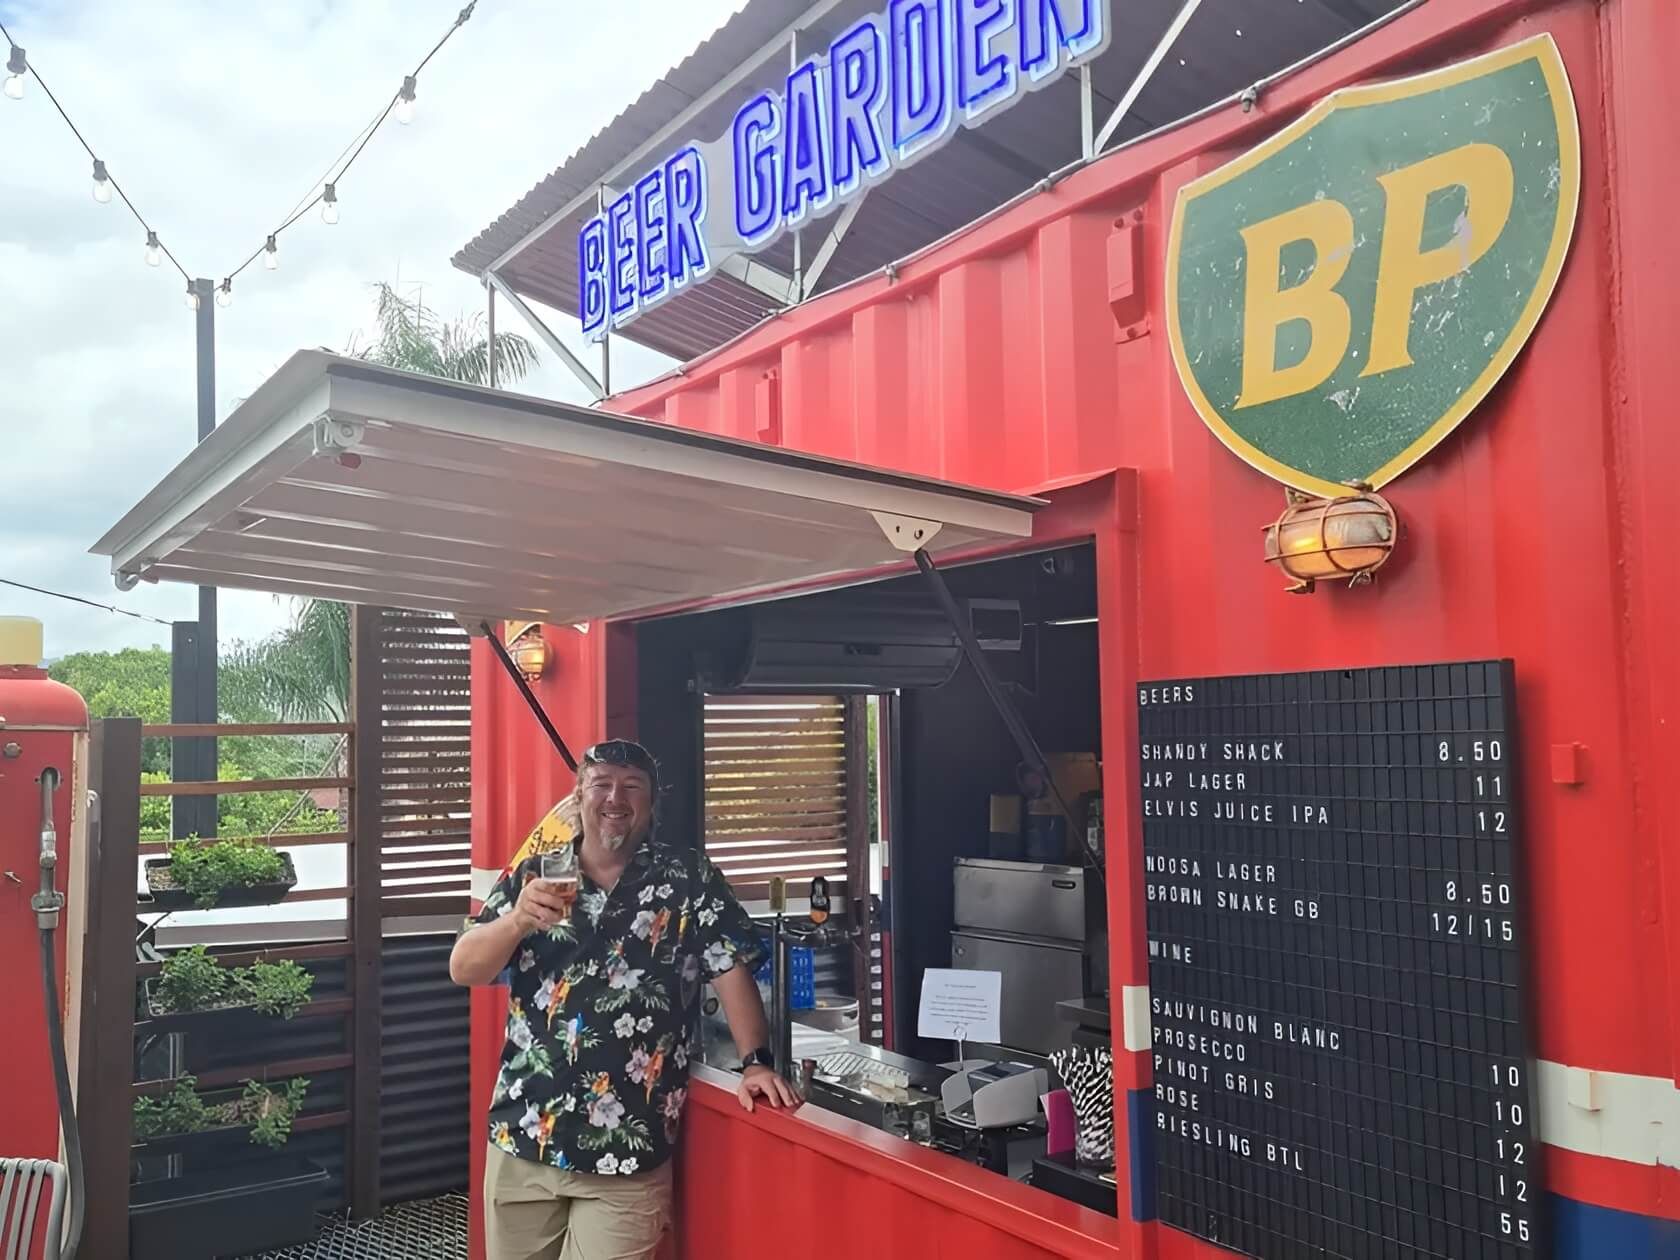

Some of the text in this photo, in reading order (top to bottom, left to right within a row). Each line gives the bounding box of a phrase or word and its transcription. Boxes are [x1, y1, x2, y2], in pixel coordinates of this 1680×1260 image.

[578, 143, 709, 343] BEER
[1232, 142, 1514, 411] BP
[1139, 684, 1195, 706] BEERS
[1141, 741, 1285, 762] SHANDY SHACK
[1438, 739, 1502, 763] 8.50
[1142, 771, 1247, 791] JAP LAGER
[1476, 775, 1502, 797] 11
[1144, 799, 1329, 826] ELVIS JUICE IPA
[1478, 811, 1507, 834] 12
[1146, 855, 1277, 884] NOOSA LAGER
[1147, 884, 1320, 920] BROWN SNAKE GB
[1445, 879, 1511, 906] 8.50
[1431, 911, 1514, 943] 12/15
[1148, 939, 1193, 965] WINE
[1152, 996, 1341, 1051] SAUVIGNON BLANC
[1153, 1025, 1247, 1063] PROSECCO
[1154, 1053, 1275, 1101] PINOT GRIS
[1492, 1063, 1520, 1088] 10
[1155, 1082, 1200, 1112] ROSE
[1495, 1100, 1524, 1127] 10
[1156, 1110, 1304, 1172] RIESLING BTL
[1496, 1138, 1525, 1166] 12
[1498, 1174, 1528, 1203] 12
[1499, 1211, 1530, 1243] 55
